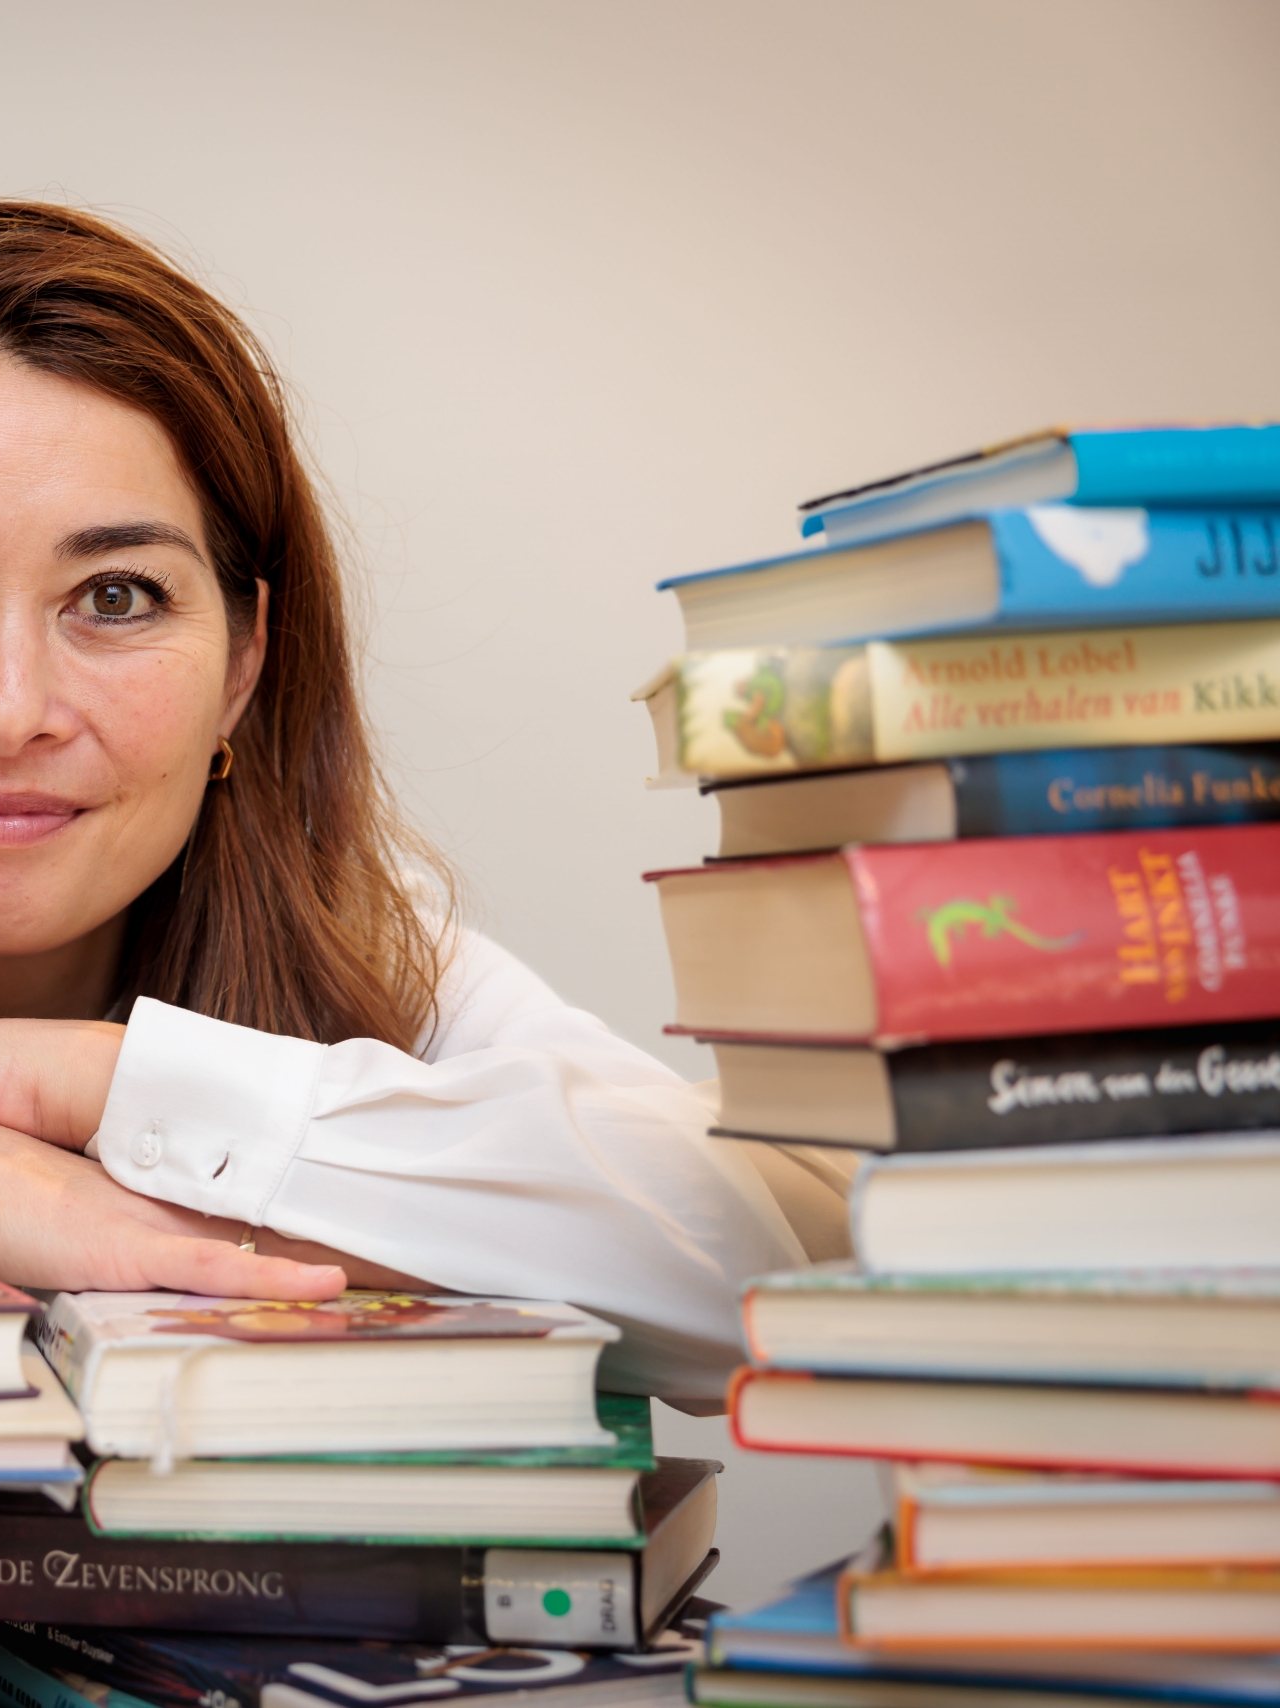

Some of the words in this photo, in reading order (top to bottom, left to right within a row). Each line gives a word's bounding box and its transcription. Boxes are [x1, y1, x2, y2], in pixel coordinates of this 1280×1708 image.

[903, 646, 1027, 687] Arnold
[1037, 637, 1138, 678] Lobel
[903, 693, 967, 733] Alle
[975, 685, 1114, 729] verhalen
[1122, 688, 1183, 716] van
[1047, 773, 1185, 813] Cornelia
